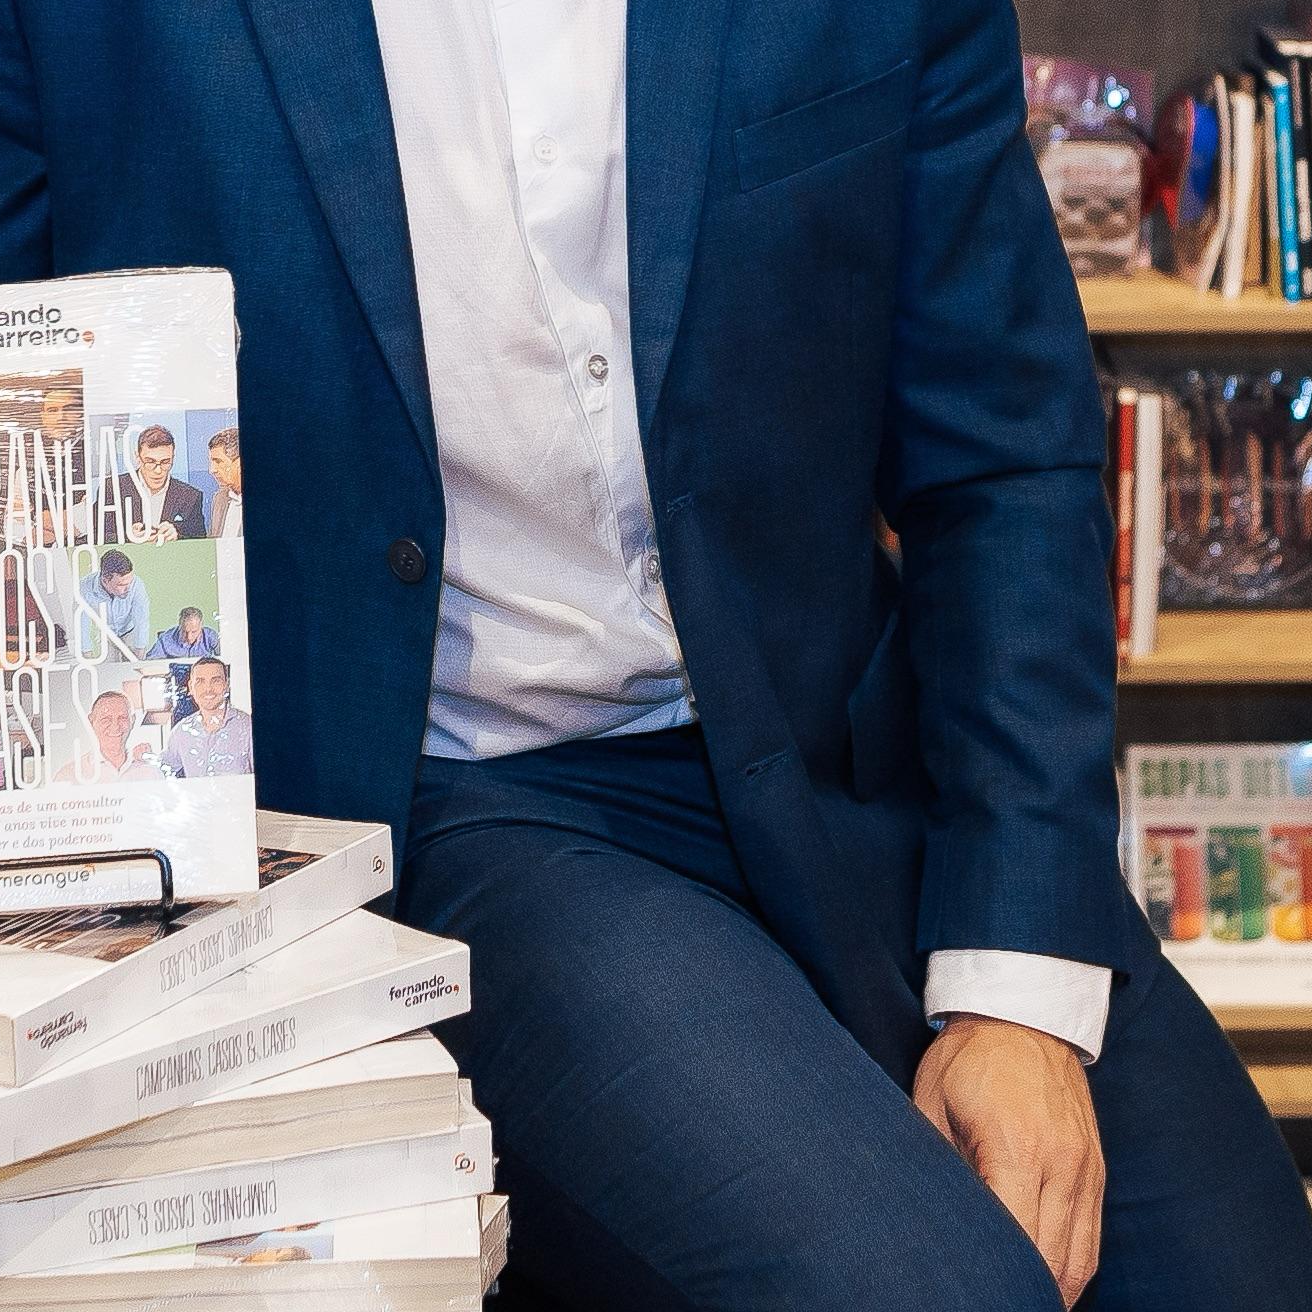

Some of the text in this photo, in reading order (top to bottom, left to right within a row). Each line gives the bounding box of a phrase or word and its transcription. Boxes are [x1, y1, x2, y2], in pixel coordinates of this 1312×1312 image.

[17, 801, 32, 814] de
[36, 800, 57, 812] um
[61, 795, 125, 811] consultor
[4, 820, 36, 833] anos
[71, 815, 88, 827] no
[92, 813, 124, 825] meio
[22, 836, 45, 849] dos
[49, 832, 113, 851] poderosos
[388, 973, 446, 1002] fernando
[40, 1015, 87, 1051] fernando
